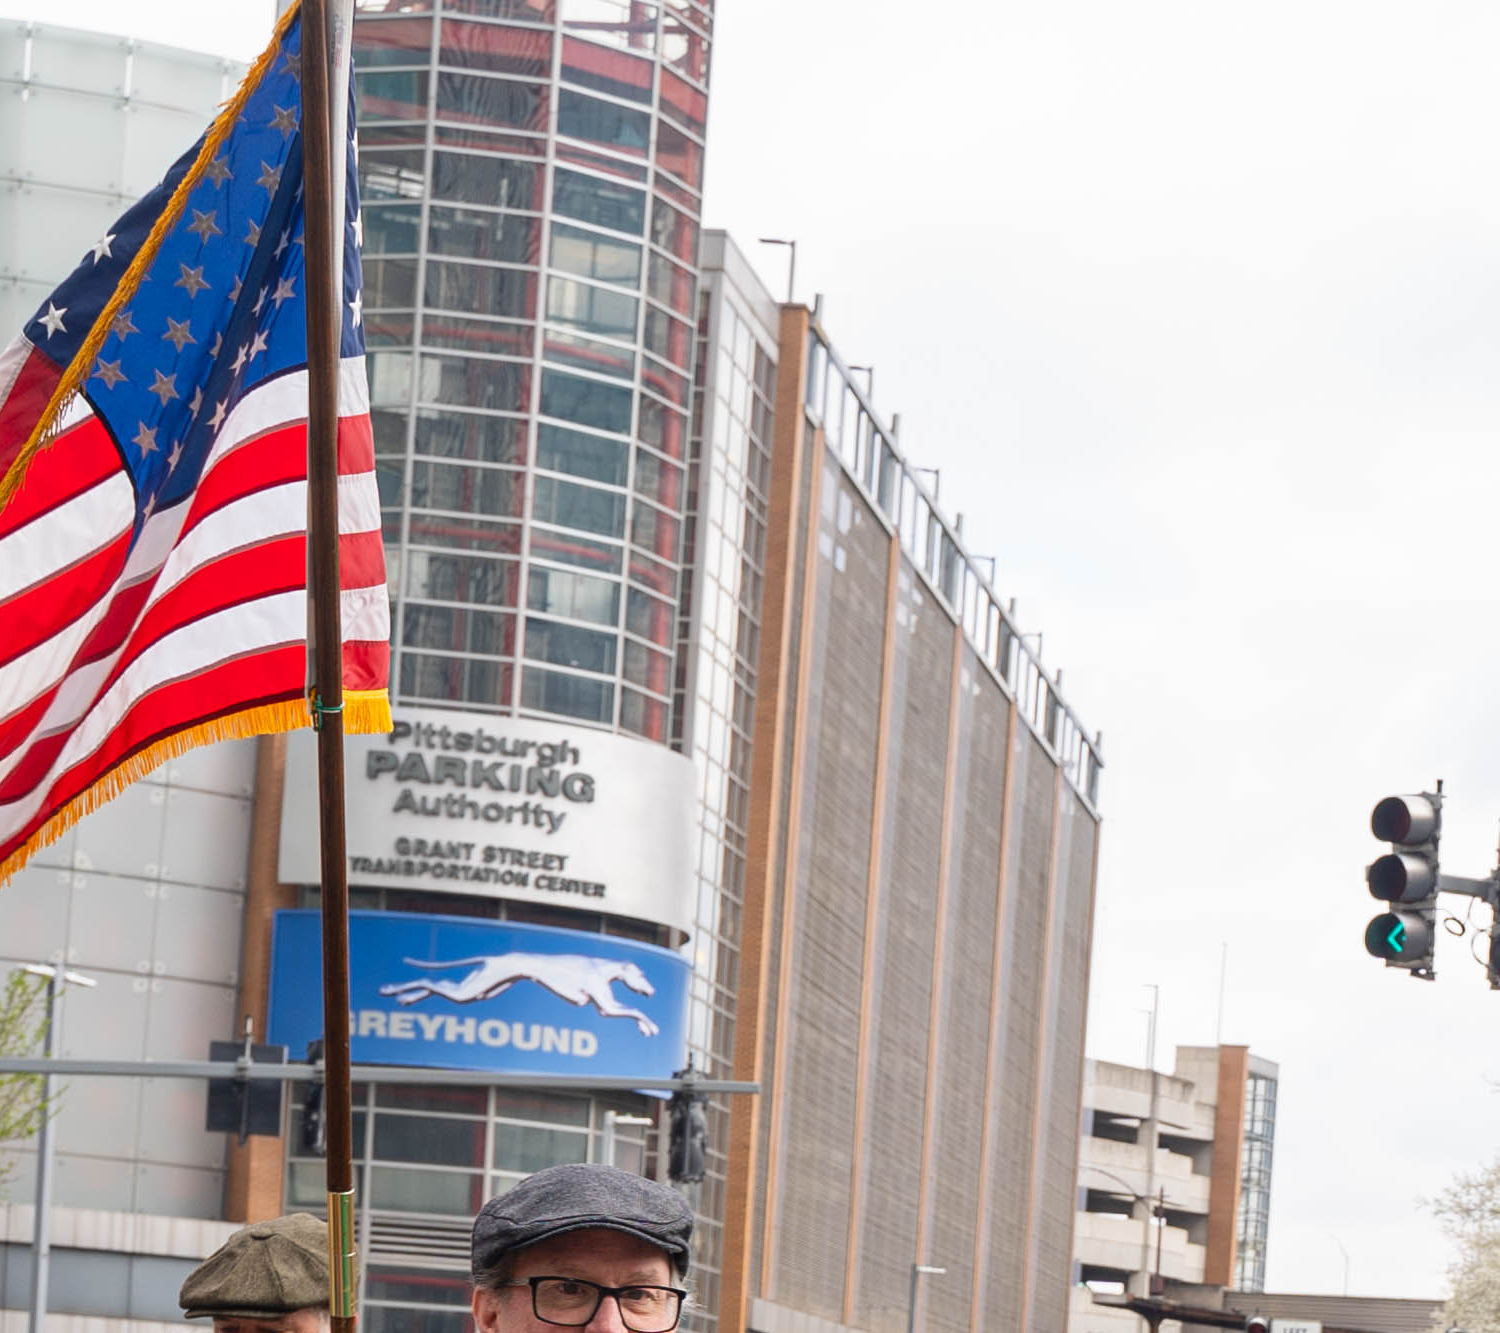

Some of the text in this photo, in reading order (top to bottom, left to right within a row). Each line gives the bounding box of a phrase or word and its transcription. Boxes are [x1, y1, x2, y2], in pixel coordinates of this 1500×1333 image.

[386, 720, 579, 768] Pittsburgh
[366, 750, 595, 803] PARKING
[393, 792, 565, 834] Authority
[394, 836, 568, 872] GRANT STREET
[348, 855, 606, 898] TRANSPORTATION CENTER
